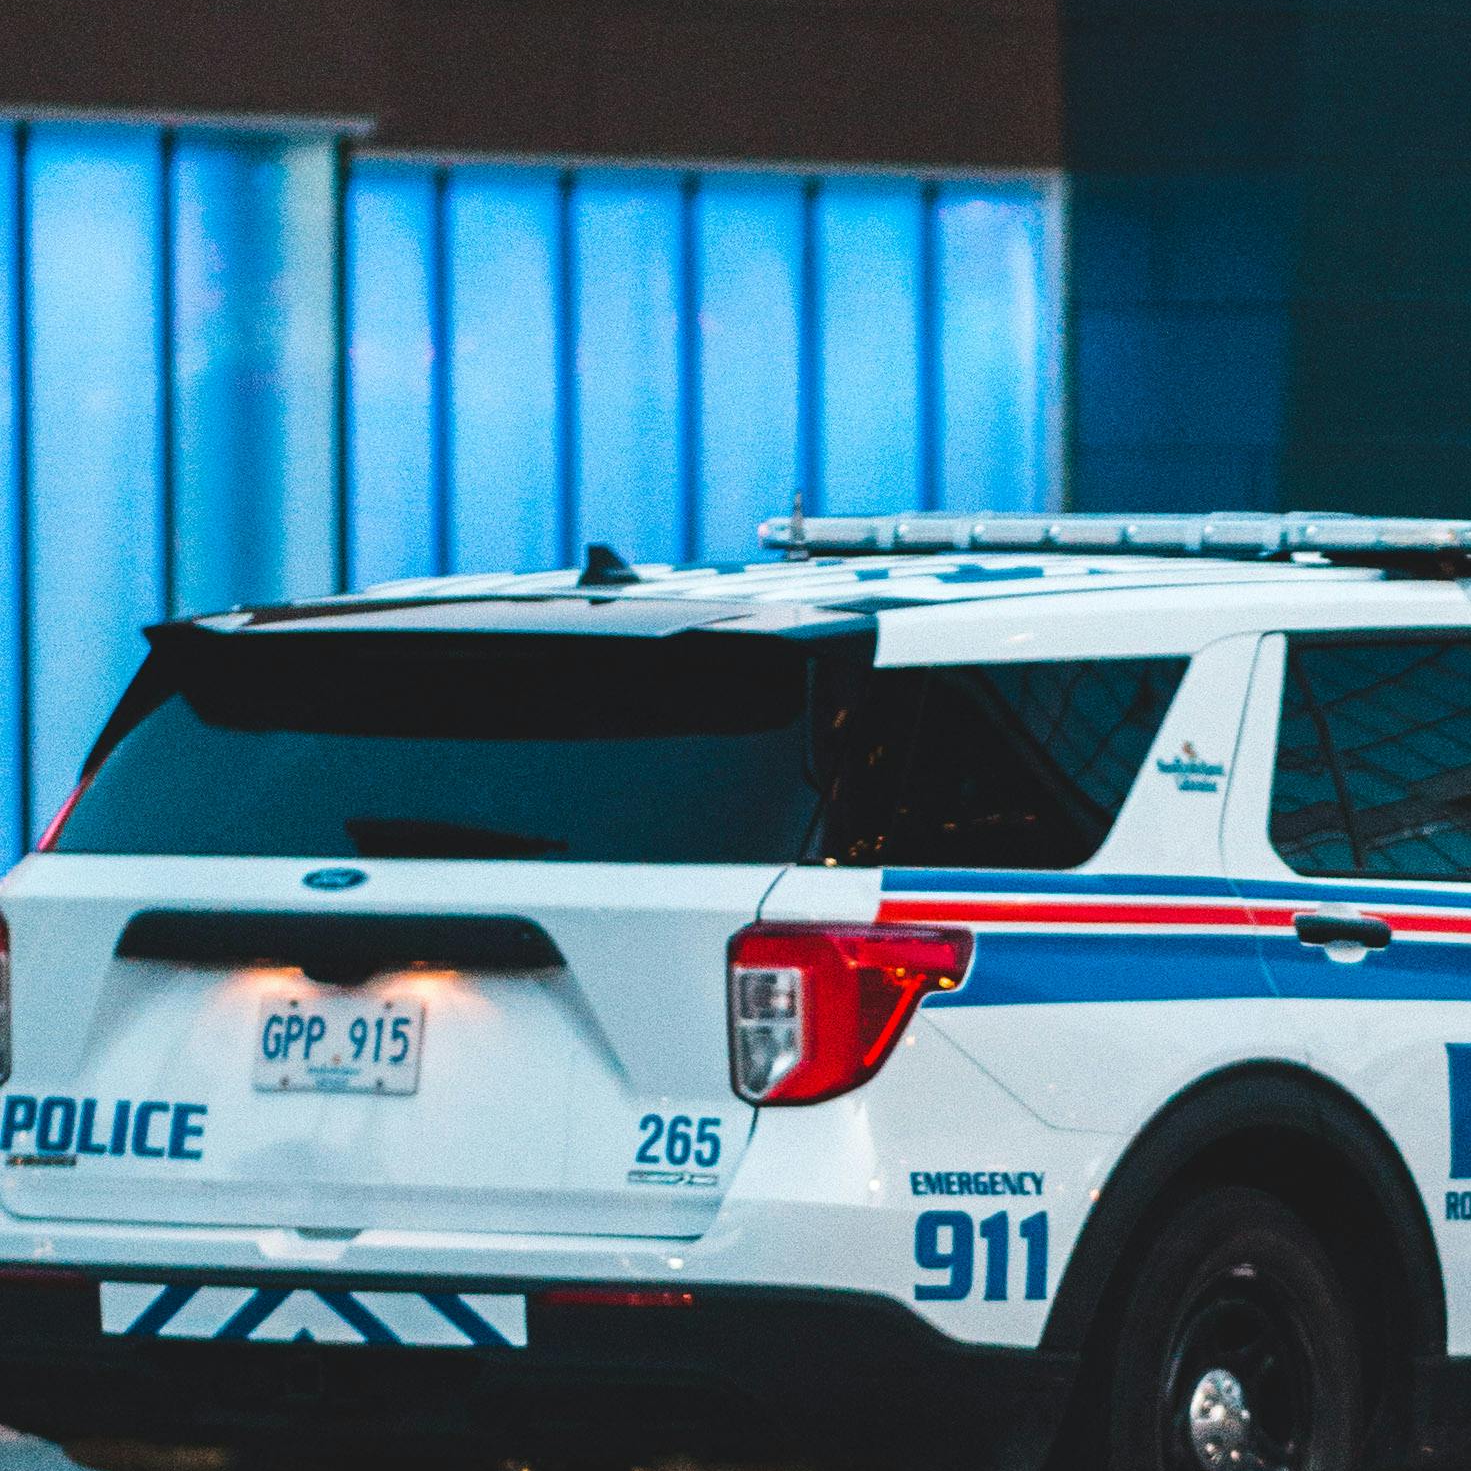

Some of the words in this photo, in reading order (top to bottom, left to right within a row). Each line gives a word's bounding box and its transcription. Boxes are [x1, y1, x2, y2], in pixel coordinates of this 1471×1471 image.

[262, 1013, 327, 1061] GPP
[349, 1016, 410, 1065] 915
[0, 1094, 208, 1161] POLICE
[635, 1113, 722, 1168] 265
[909, 1171, 1045, 1196] EMERGENCY
[914, 1210, 1048, 1302] 911
